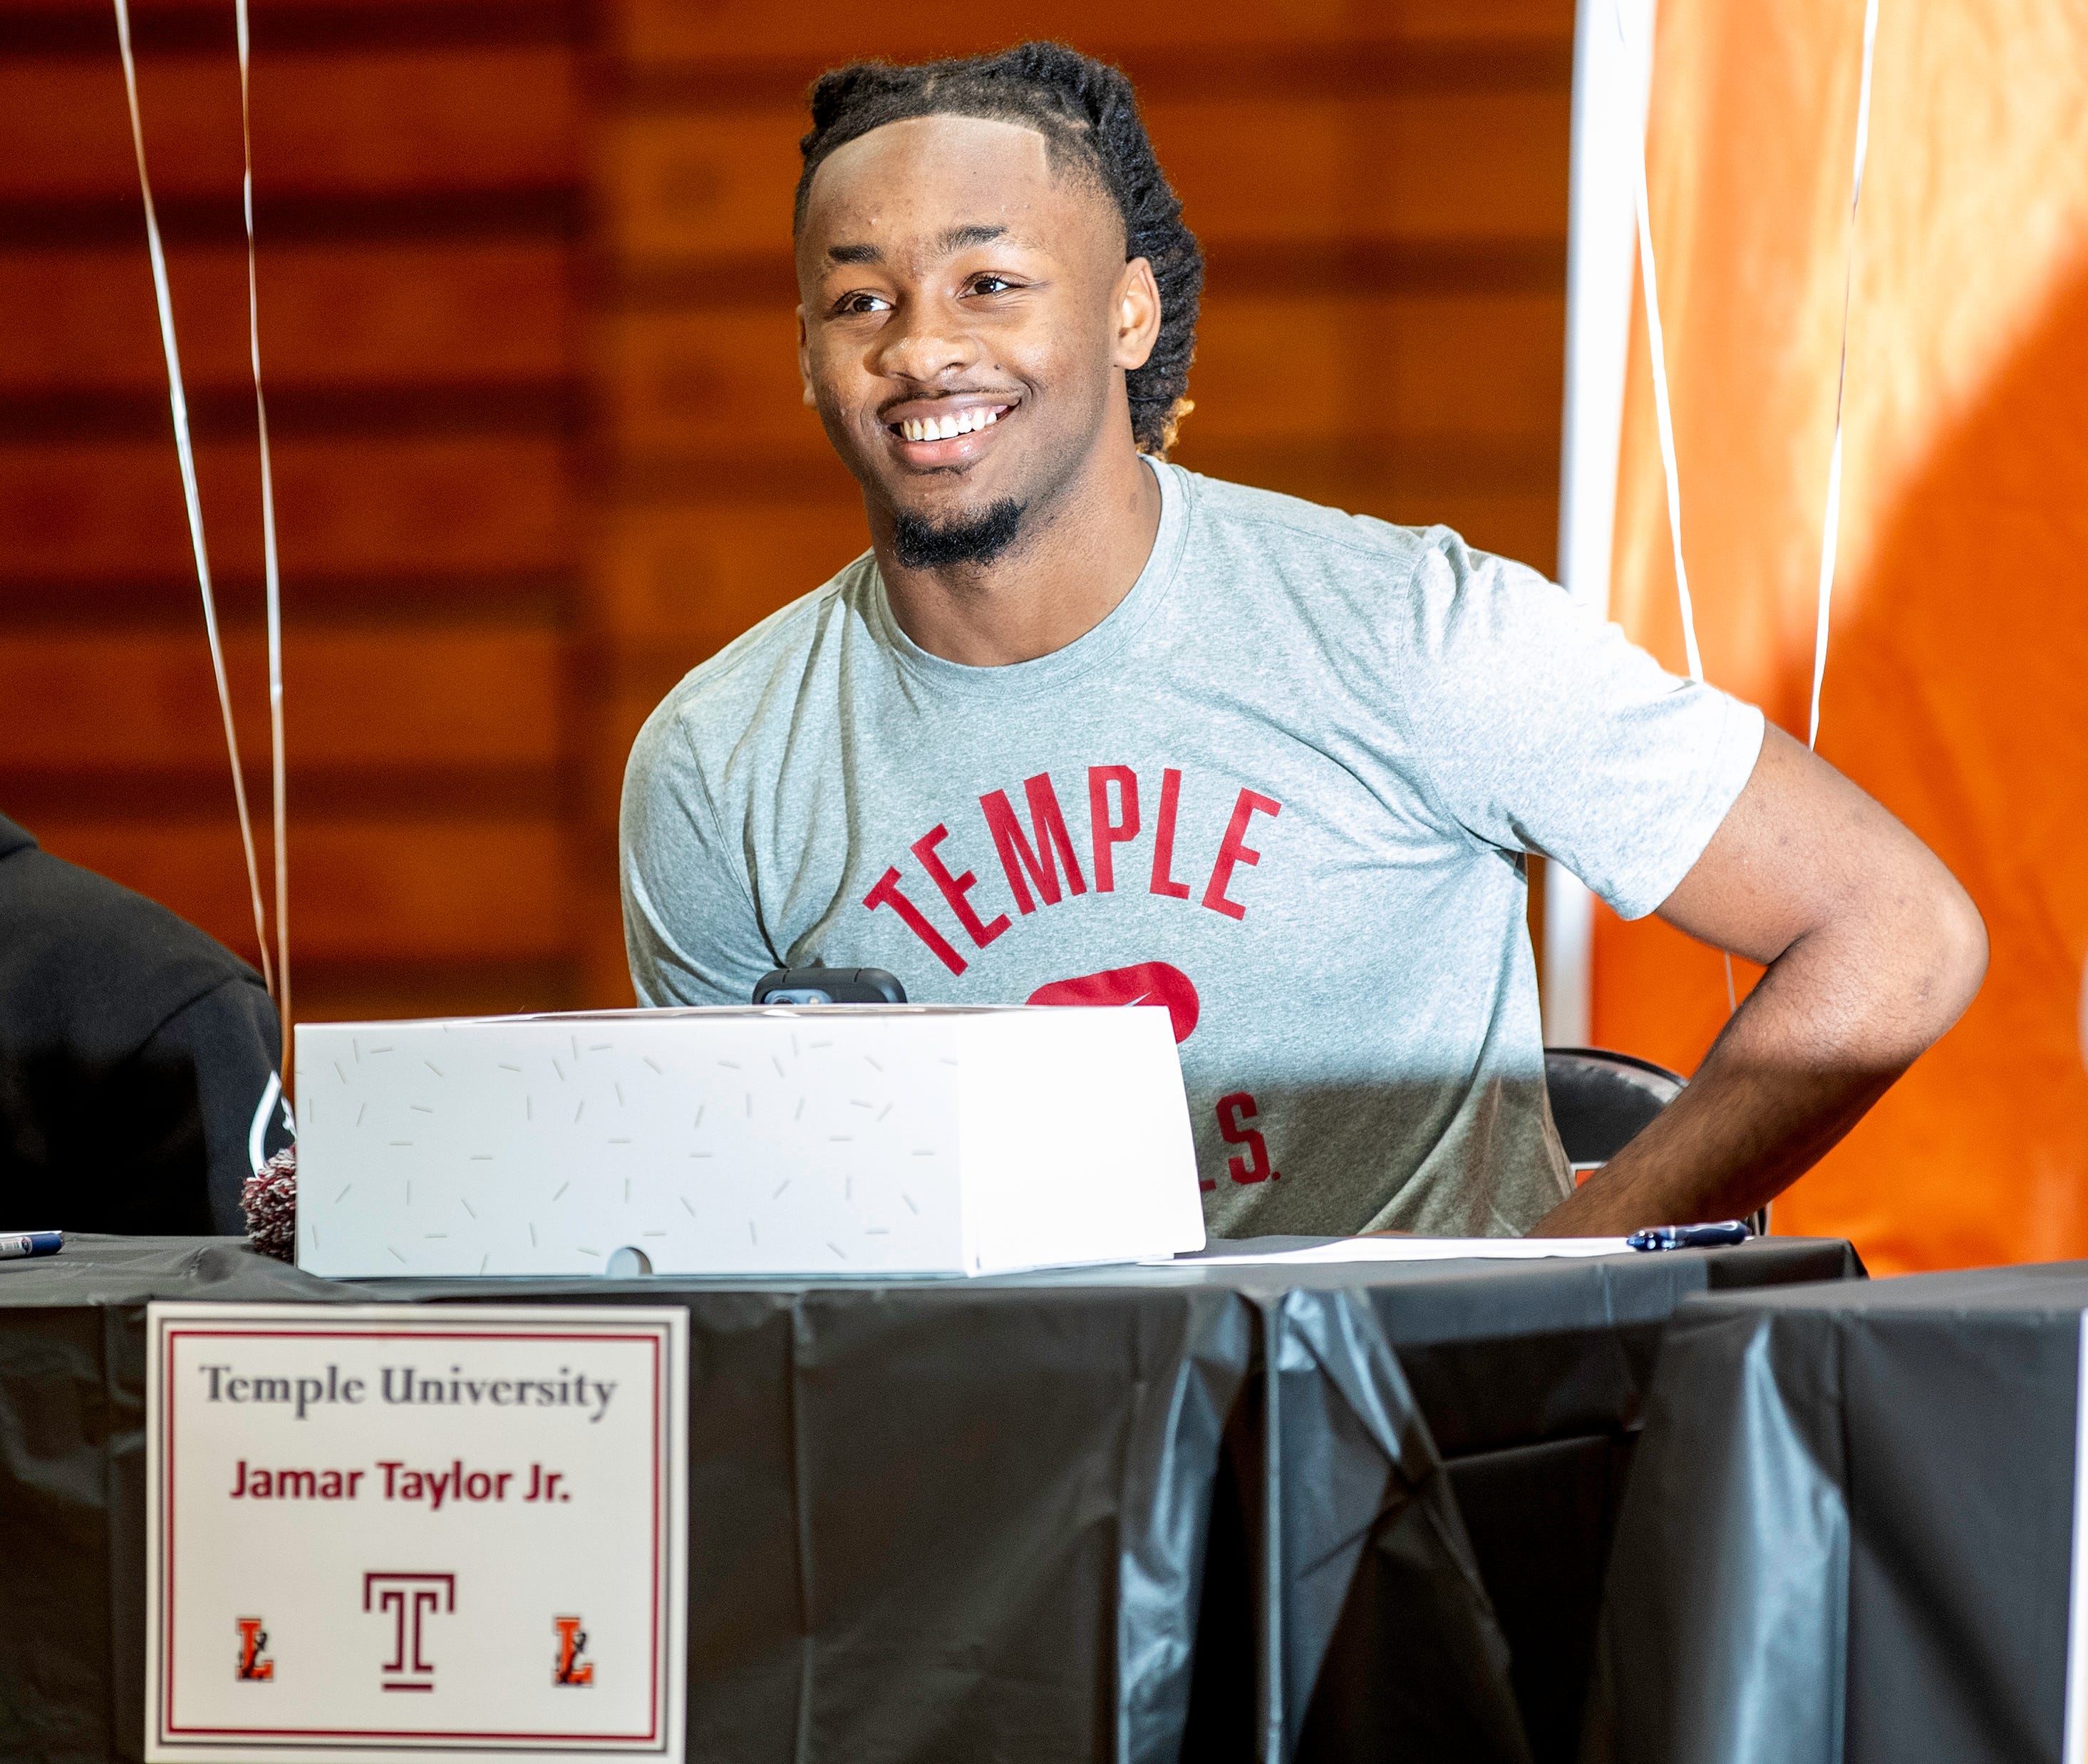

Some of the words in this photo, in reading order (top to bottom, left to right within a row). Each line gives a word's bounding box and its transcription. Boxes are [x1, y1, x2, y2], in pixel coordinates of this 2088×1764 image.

[862, 765, 1281, 976] TEMPLE
[199, 1364, 366, 1420] Temple
[381, 1366, 618, 1423] University
[229, 1458, 364, 1502] Jamar
[374, 1459, 514, 1512] Taylor
[522, 1462, 572, 1503] Jr.
